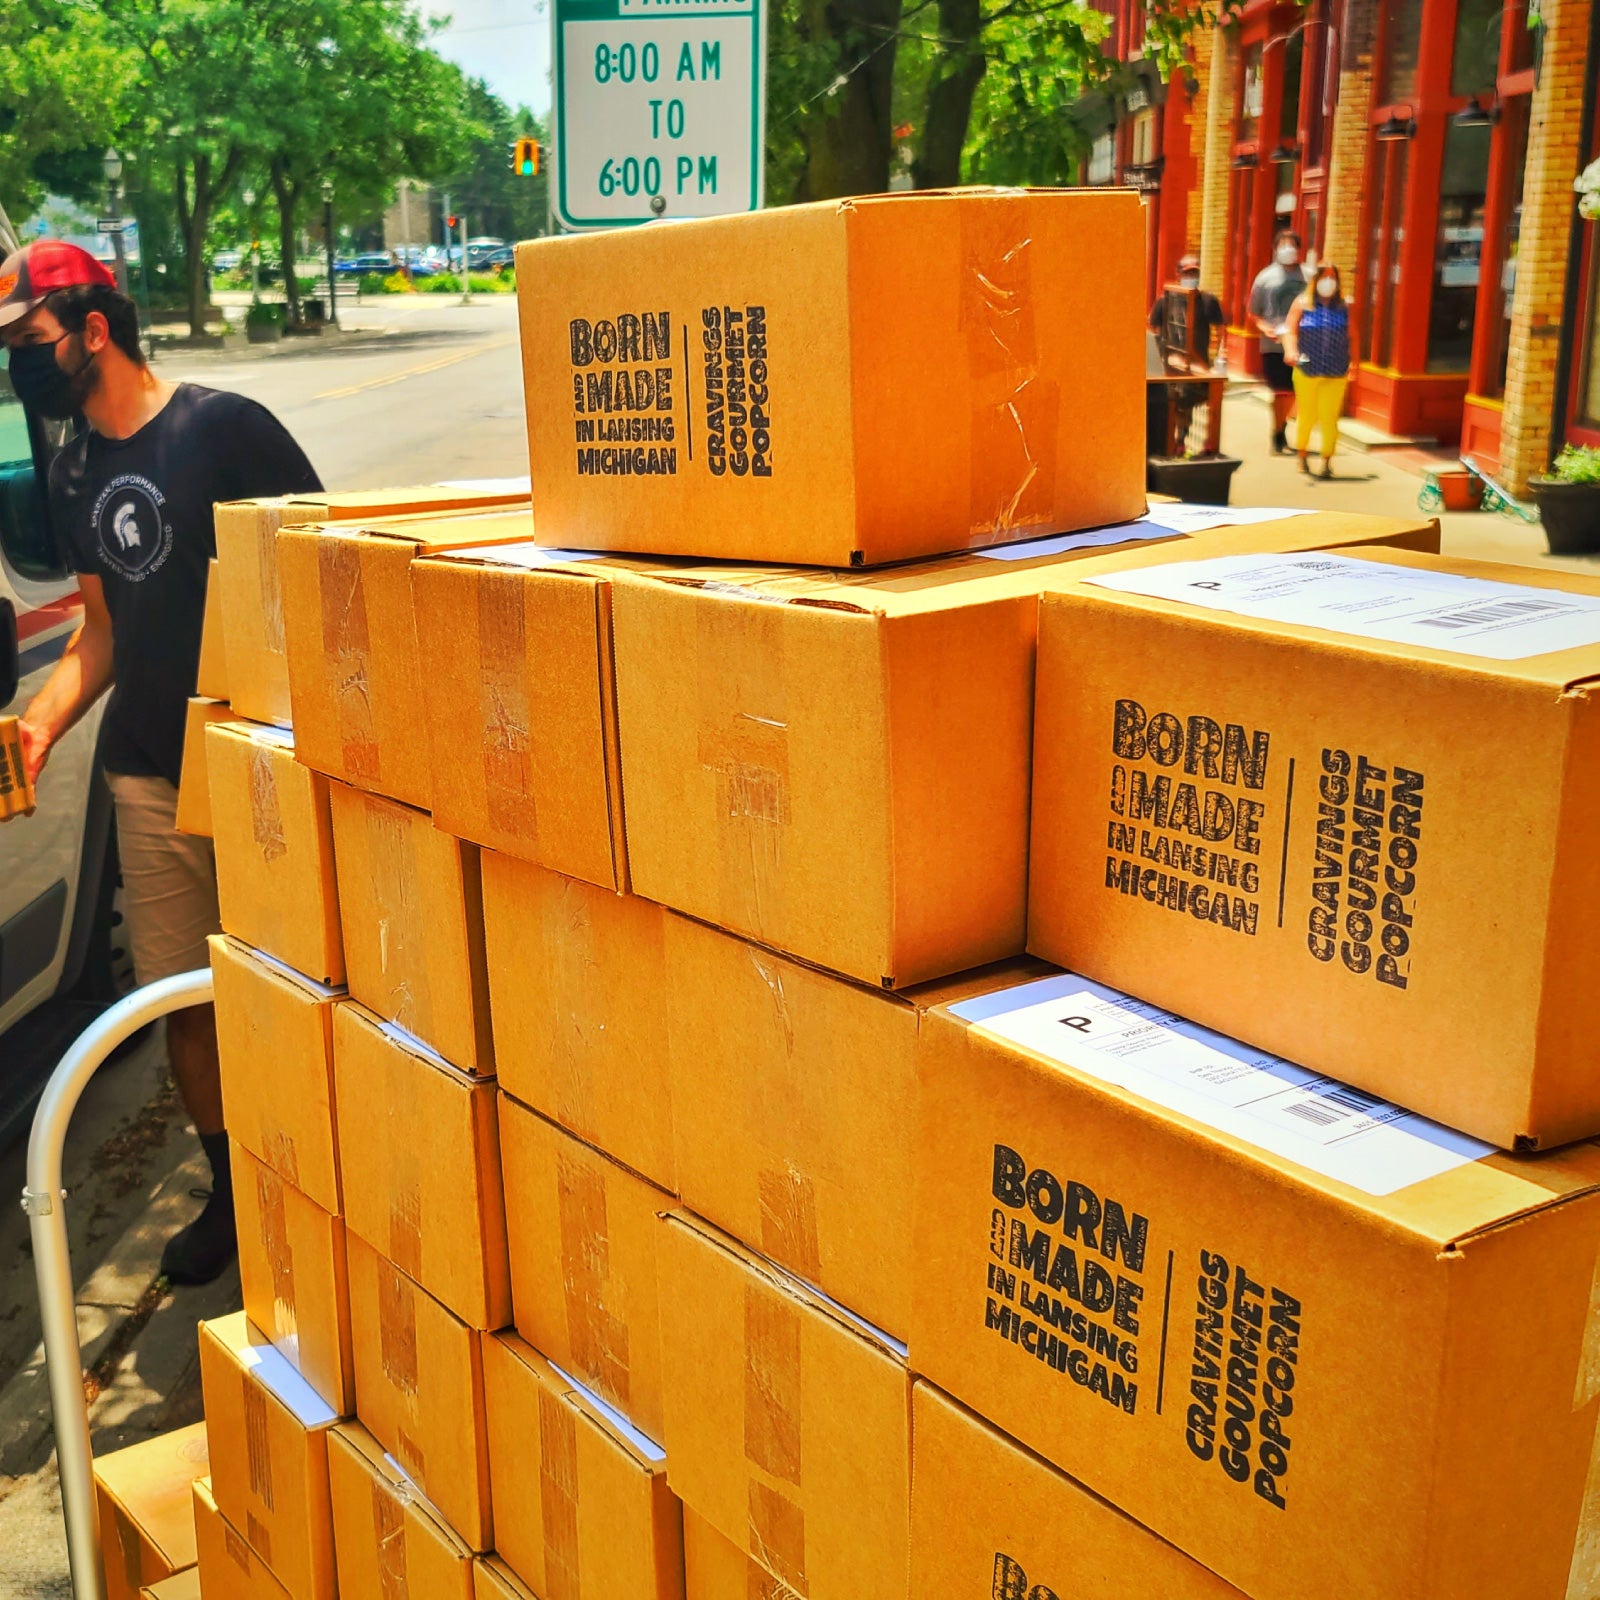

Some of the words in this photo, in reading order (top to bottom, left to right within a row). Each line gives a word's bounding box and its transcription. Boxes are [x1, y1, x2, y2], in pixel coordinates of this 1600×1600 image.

[595, 43, 659, 84] 8:00
[676, 41, 721, 81] AM
[649, 99, 684, 139] TO
[599, 157, 661, 197] 6:00
[676, 156, 717, 195] PM
[569, 312, 670, 366] BORN
[575, 420, 594, 442] IN
[598, 417, 675, 442] LANSING
[586, 368, 672, 413] MADE
[702, 306, 727, 477] CRAVINGS
[724, 305, 749, 477] GOURMET
[746, 306, 772, 477] POPCORN
[111, 475, 166, 507] PERFORMANCE
[577, 447, 677, 475] MICHIGAN
[1112, 699, 1270, 790] BORN
[1107, 821, 1136, 854] IN
[1140, 830, 1259, 893] LANSING
[1129, 769, 1265, 856] MADE
[1308, 748, 1350, 962] CRAVINGS
[1105, 856, 1259, 936] MICHIGAN
[1341, 755, 1387, 974] GOURMET
[1376, 766, 1424, 990] POPCORN
[1057, 1016, 1092, 1033] P
[992, 1143, 1149, 1274] BORN
[987, 1262, 1016, 1301] IN
[1020, 1282, 1138, 1373] LANSING
[1009, 1218, 1143, 1337] MADE
[985, 1296, 1137, 1415] MICHIGAN
[1186, 1248, 1230, 1461] CRAVINGS
[1220, 1266, 1265, 1483] GOURMET
[1254, 1287, 1301, 1510] POPCORN
